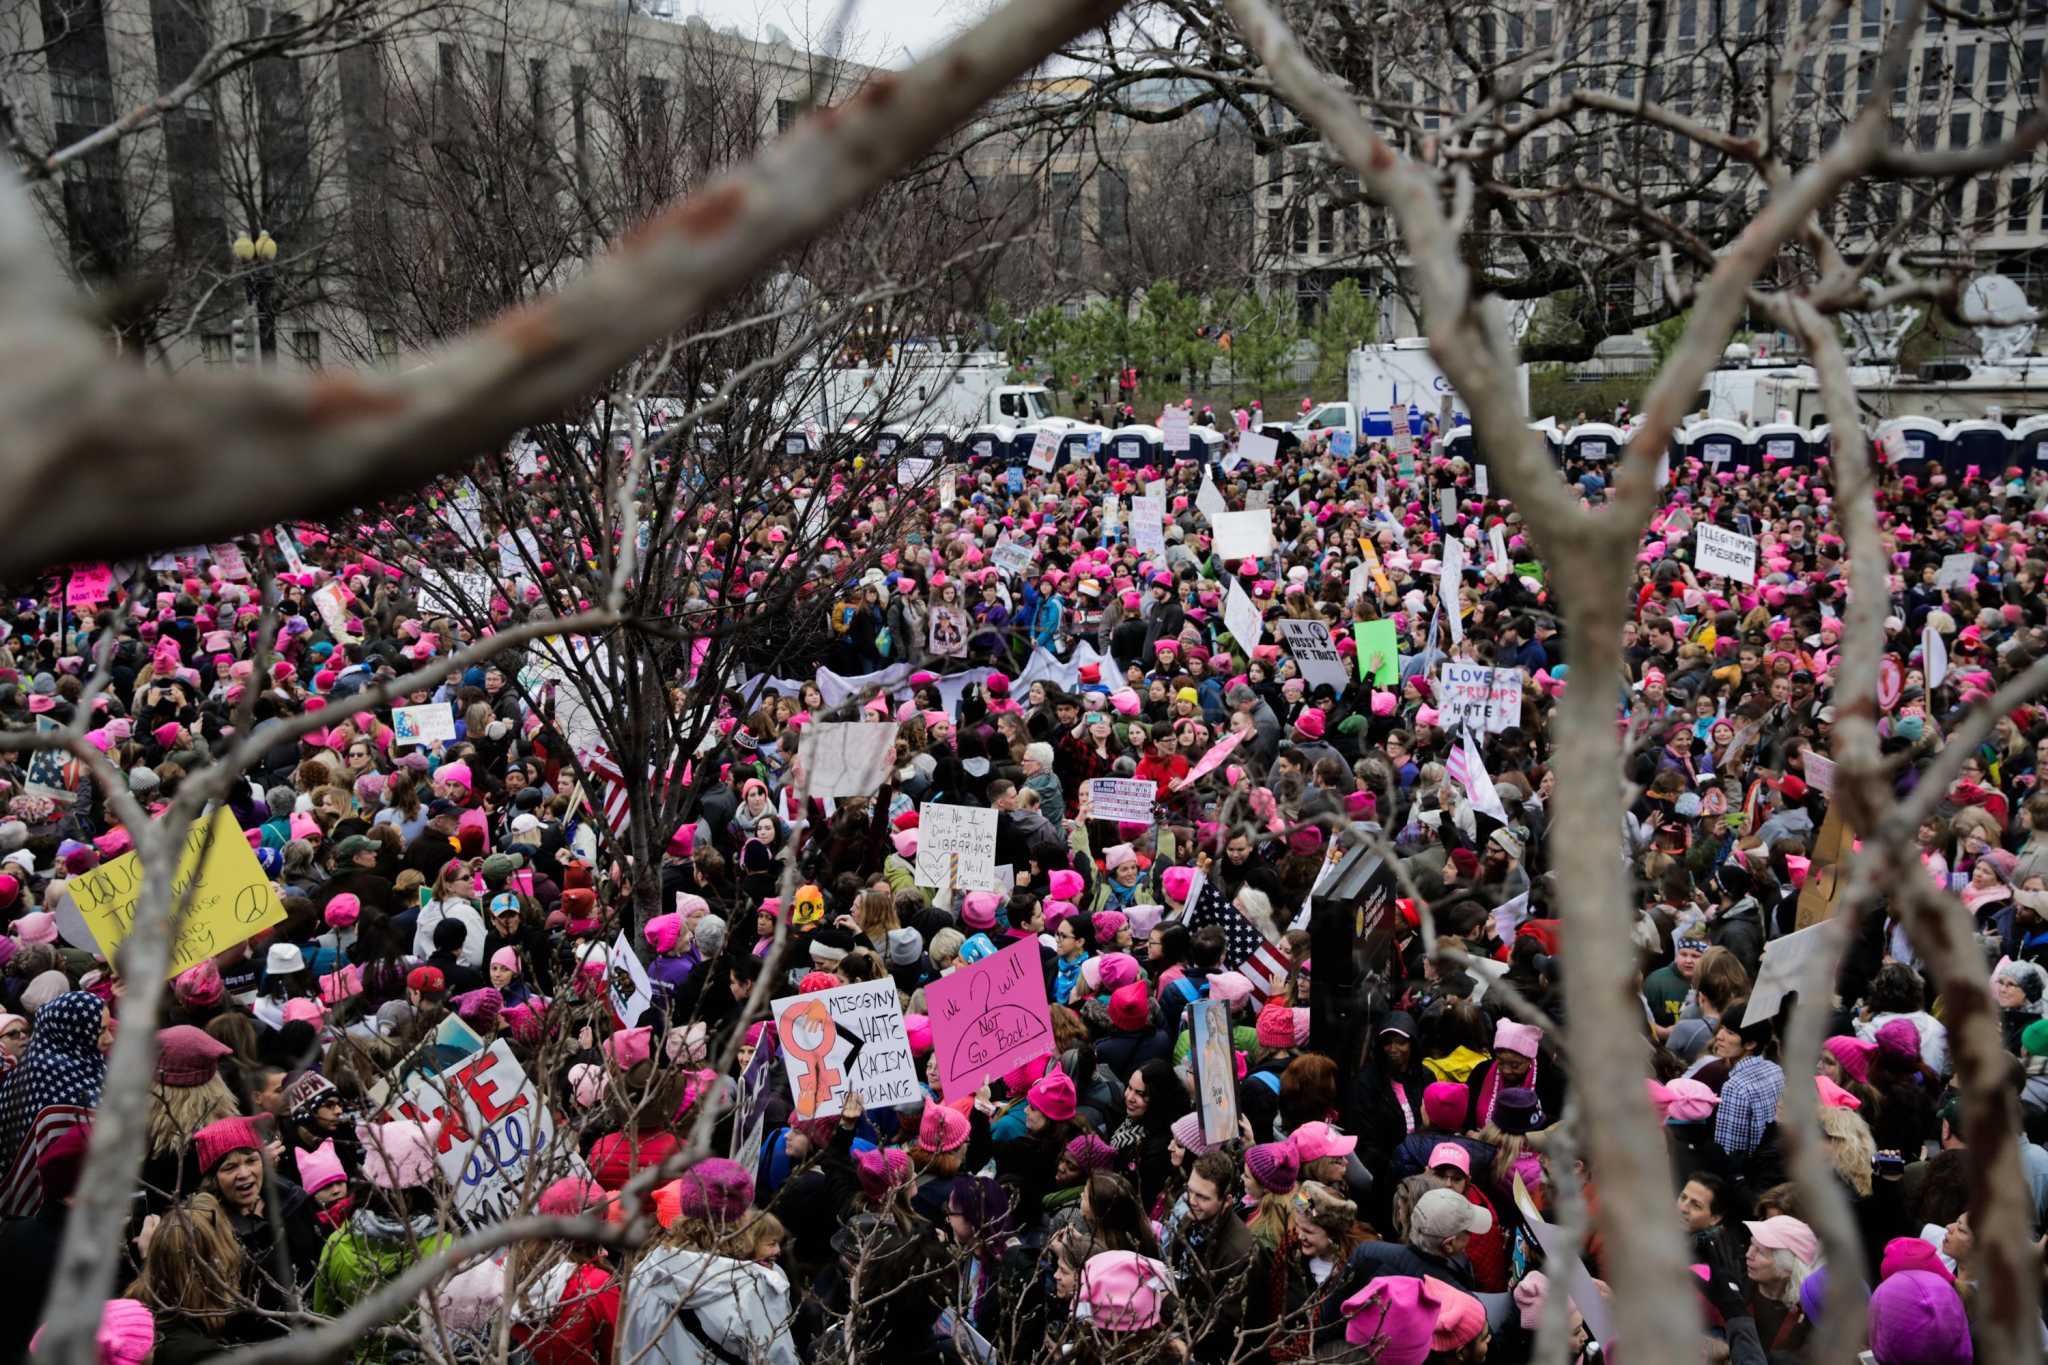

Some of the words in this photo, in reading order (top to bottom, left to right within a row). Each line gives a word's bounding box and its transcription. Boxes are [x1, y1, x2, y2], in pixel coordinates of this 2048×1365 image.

[1290, 624, 1303, 634] IN
[1288, 637, 1316, 648] PUSSY
[1293, 649, 1309, 660] WE
[1310, 650, 1338, 661] TRUST
[1449, 668, 1493, 684] LOVE
[1456, 685, 1517, 704] TRUMPS
[1453, 703, 1493, 717] HATE
[998, 952, 1025, 995] will
[829, 990, 895, 1017] MISOGYNY
[858, 1013, 904, 1044] HATE
[968, 1041, 988, 1064] Go
[994, 1015, 1030, 1050] Back!
[857, 1049, 912, 1081] RACISM
